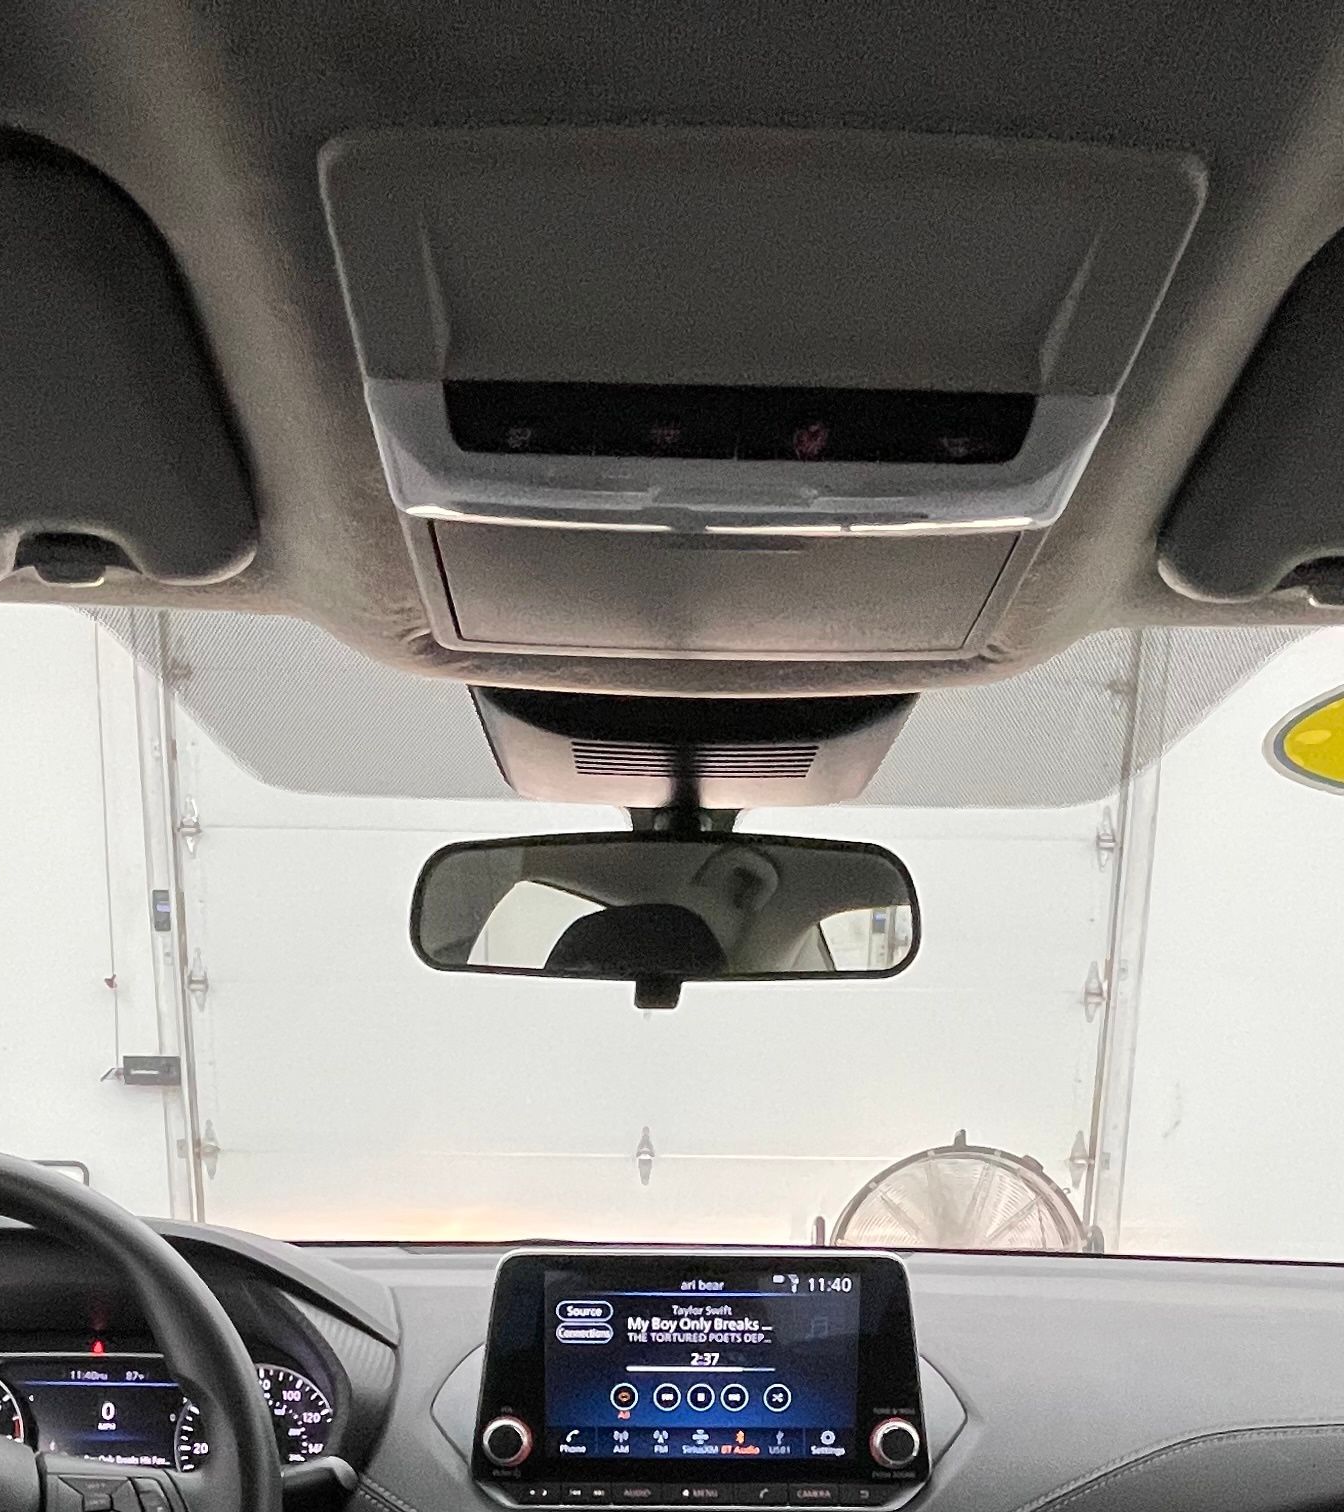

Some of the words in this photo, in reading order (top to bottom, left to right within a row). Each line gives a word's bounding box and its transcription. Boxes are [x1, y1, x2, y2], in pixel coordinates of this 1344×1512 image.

[808, 1277, 853, 1292] 11:40
[566, 1305, 603, 1317] Source
[672, 1304, 703, 1317] Taylor
[705, 1304, 733, 1316] Swift
[627, 1317, 649, 1333] My
[651, 1317, 677, 1333] Boy
[679, 1316, 713, 1332] Only
[714, 1316, 760, 1331] Breaks
[558, 1327, 611, 1340] Connections
[627, 1332, 648, 1343] THE
[651, 1332, 706, 1343] TORTURED
[709, 1332, 742, 1343] POETS
[690, 1352, 720, 1366] 2:37
[281, 1390, 302, 1402] 100
[101, 1401, 116, 1421] 0
[302, 1411, 322, 1424] 120
[192, 1442, 209, 1455] 20
[559, 1444, 587, 1454] Phone
[613, 1444, 630, 1454] AM
[654, 1444, 669, 1454] FM
[735, 1444, 760, 1454] Audio
[810, 1444, 846, 1456] Settings
[796, 1488, 832, 1499] CAMERA
